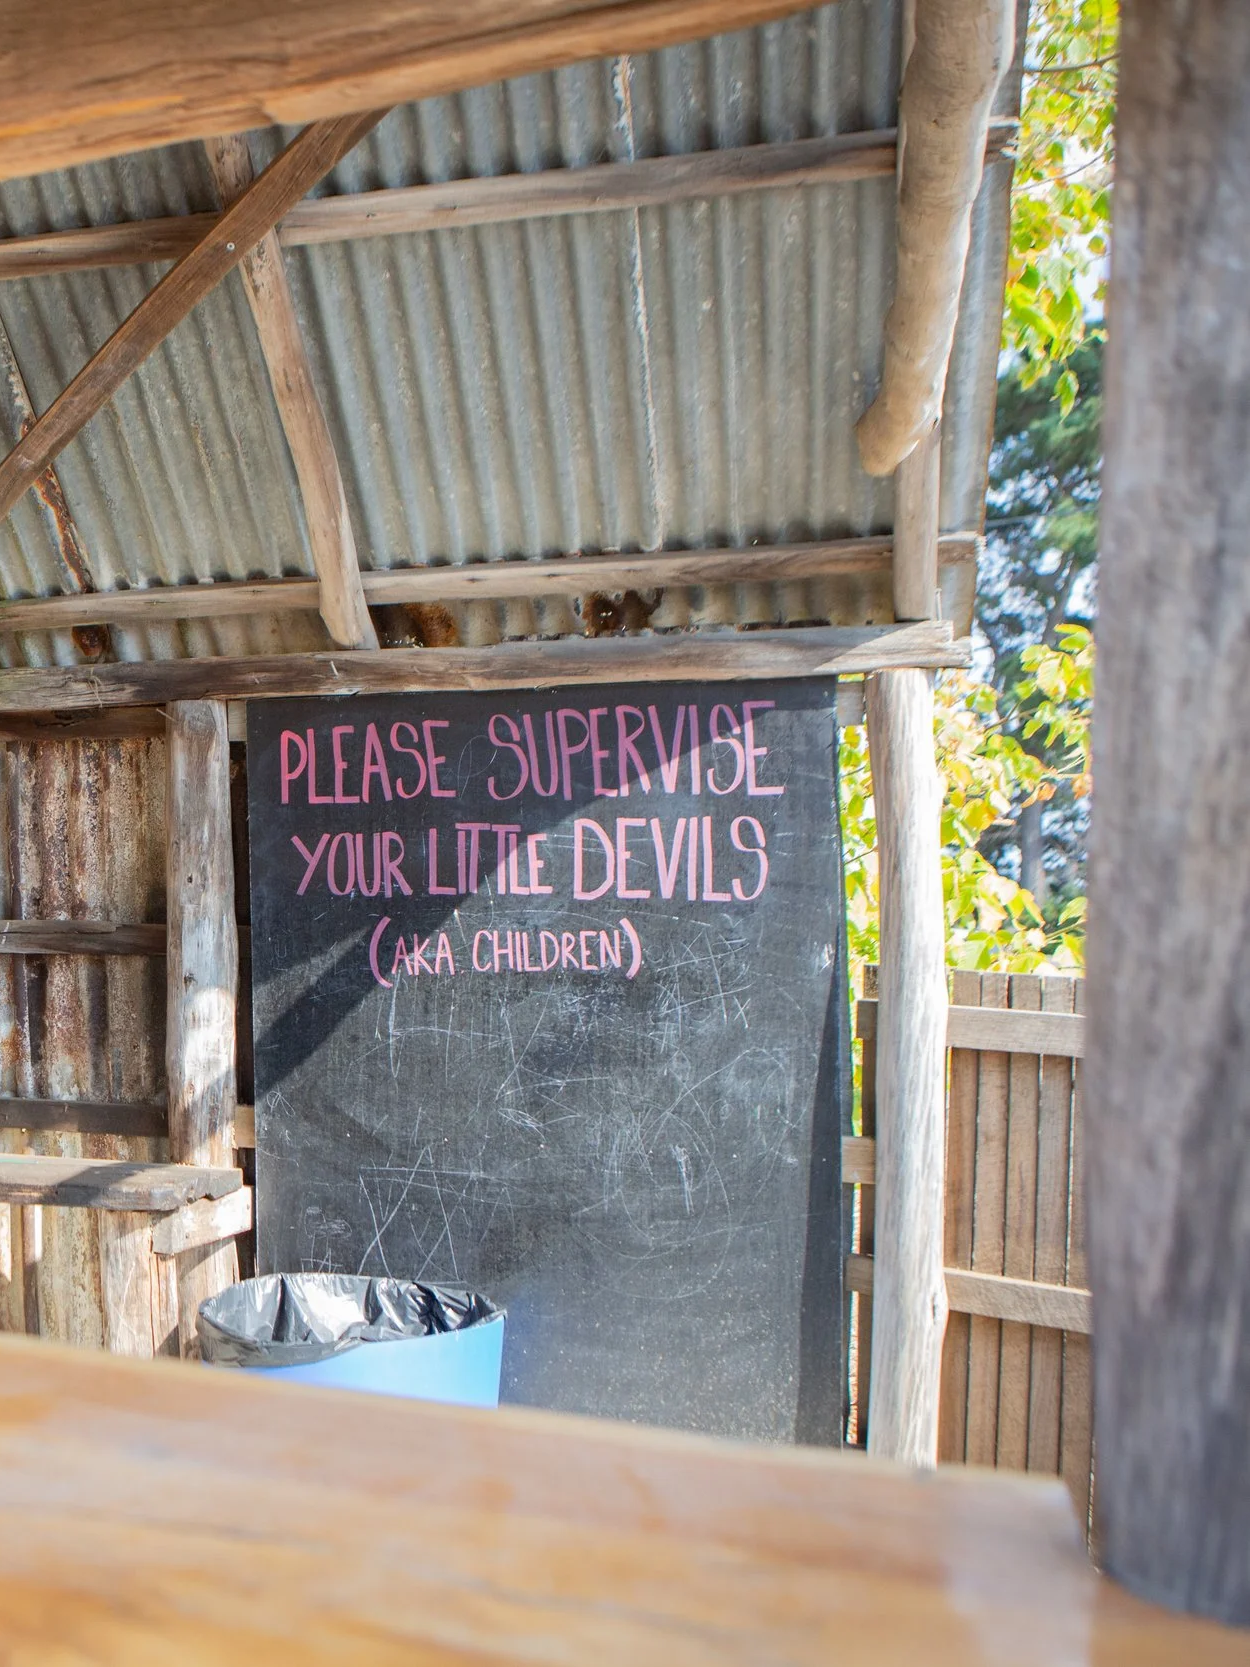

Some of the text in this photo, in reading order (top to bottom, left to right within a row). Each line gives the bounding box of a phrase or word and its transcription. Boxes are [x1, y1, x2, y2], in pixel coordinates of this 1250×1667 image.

[281, 700, 785, 804] PLEASE SUPERVISE
[291, 815, 768, 901] YOUR LITTLE DEVILS
[369, 916, 643, 989] (AKA CHILDREN)
